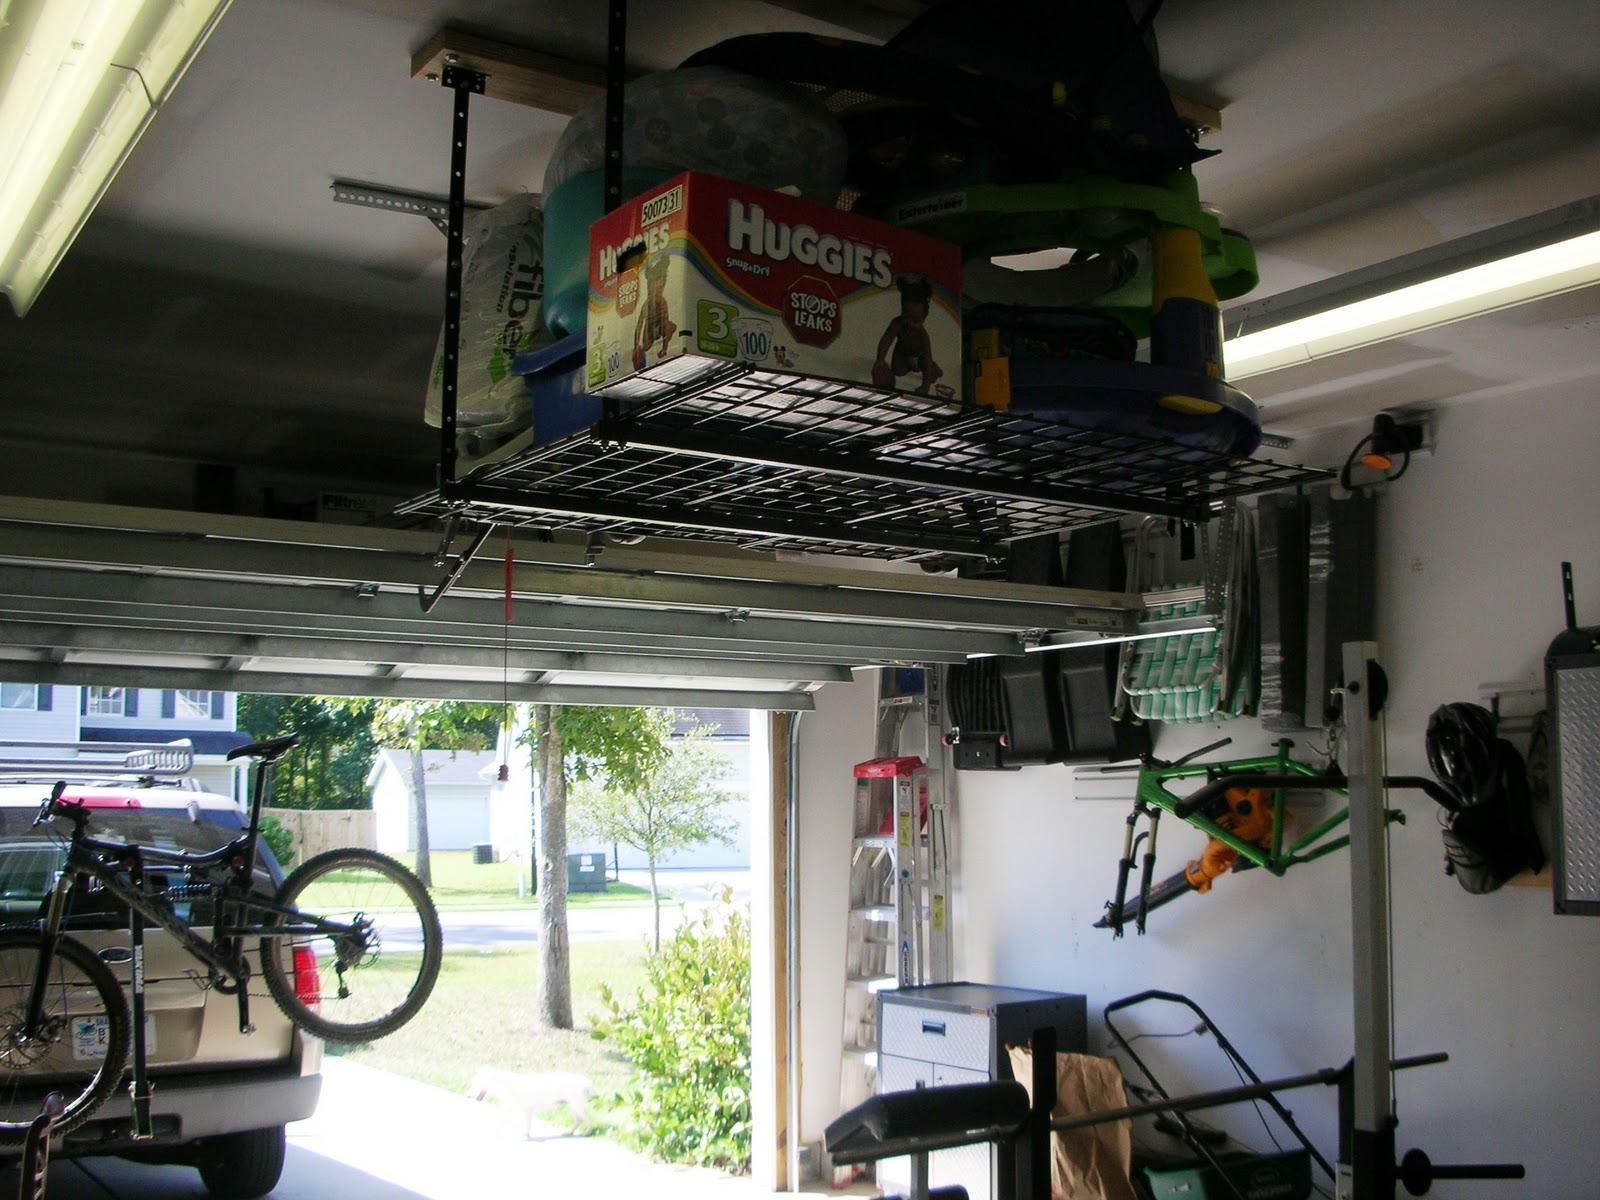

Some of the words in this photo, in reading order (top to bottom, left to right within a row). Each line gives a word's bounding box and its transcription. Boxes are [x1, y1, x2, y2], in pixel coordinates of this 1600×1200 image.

[642, 196, 667, 223] 50073
[669, 190, 679, 211] 31
[727, 198, 892, 288] HUGGIES
[790, 292, 837, 318] STOPS
[707, 307, 729, 339] 3
[795, 311, 833, 332] LEAKS
[743, 332, 767, 356] 100
[592, 349, 602, 374] 3
[607, 352, 620, 373] 100
